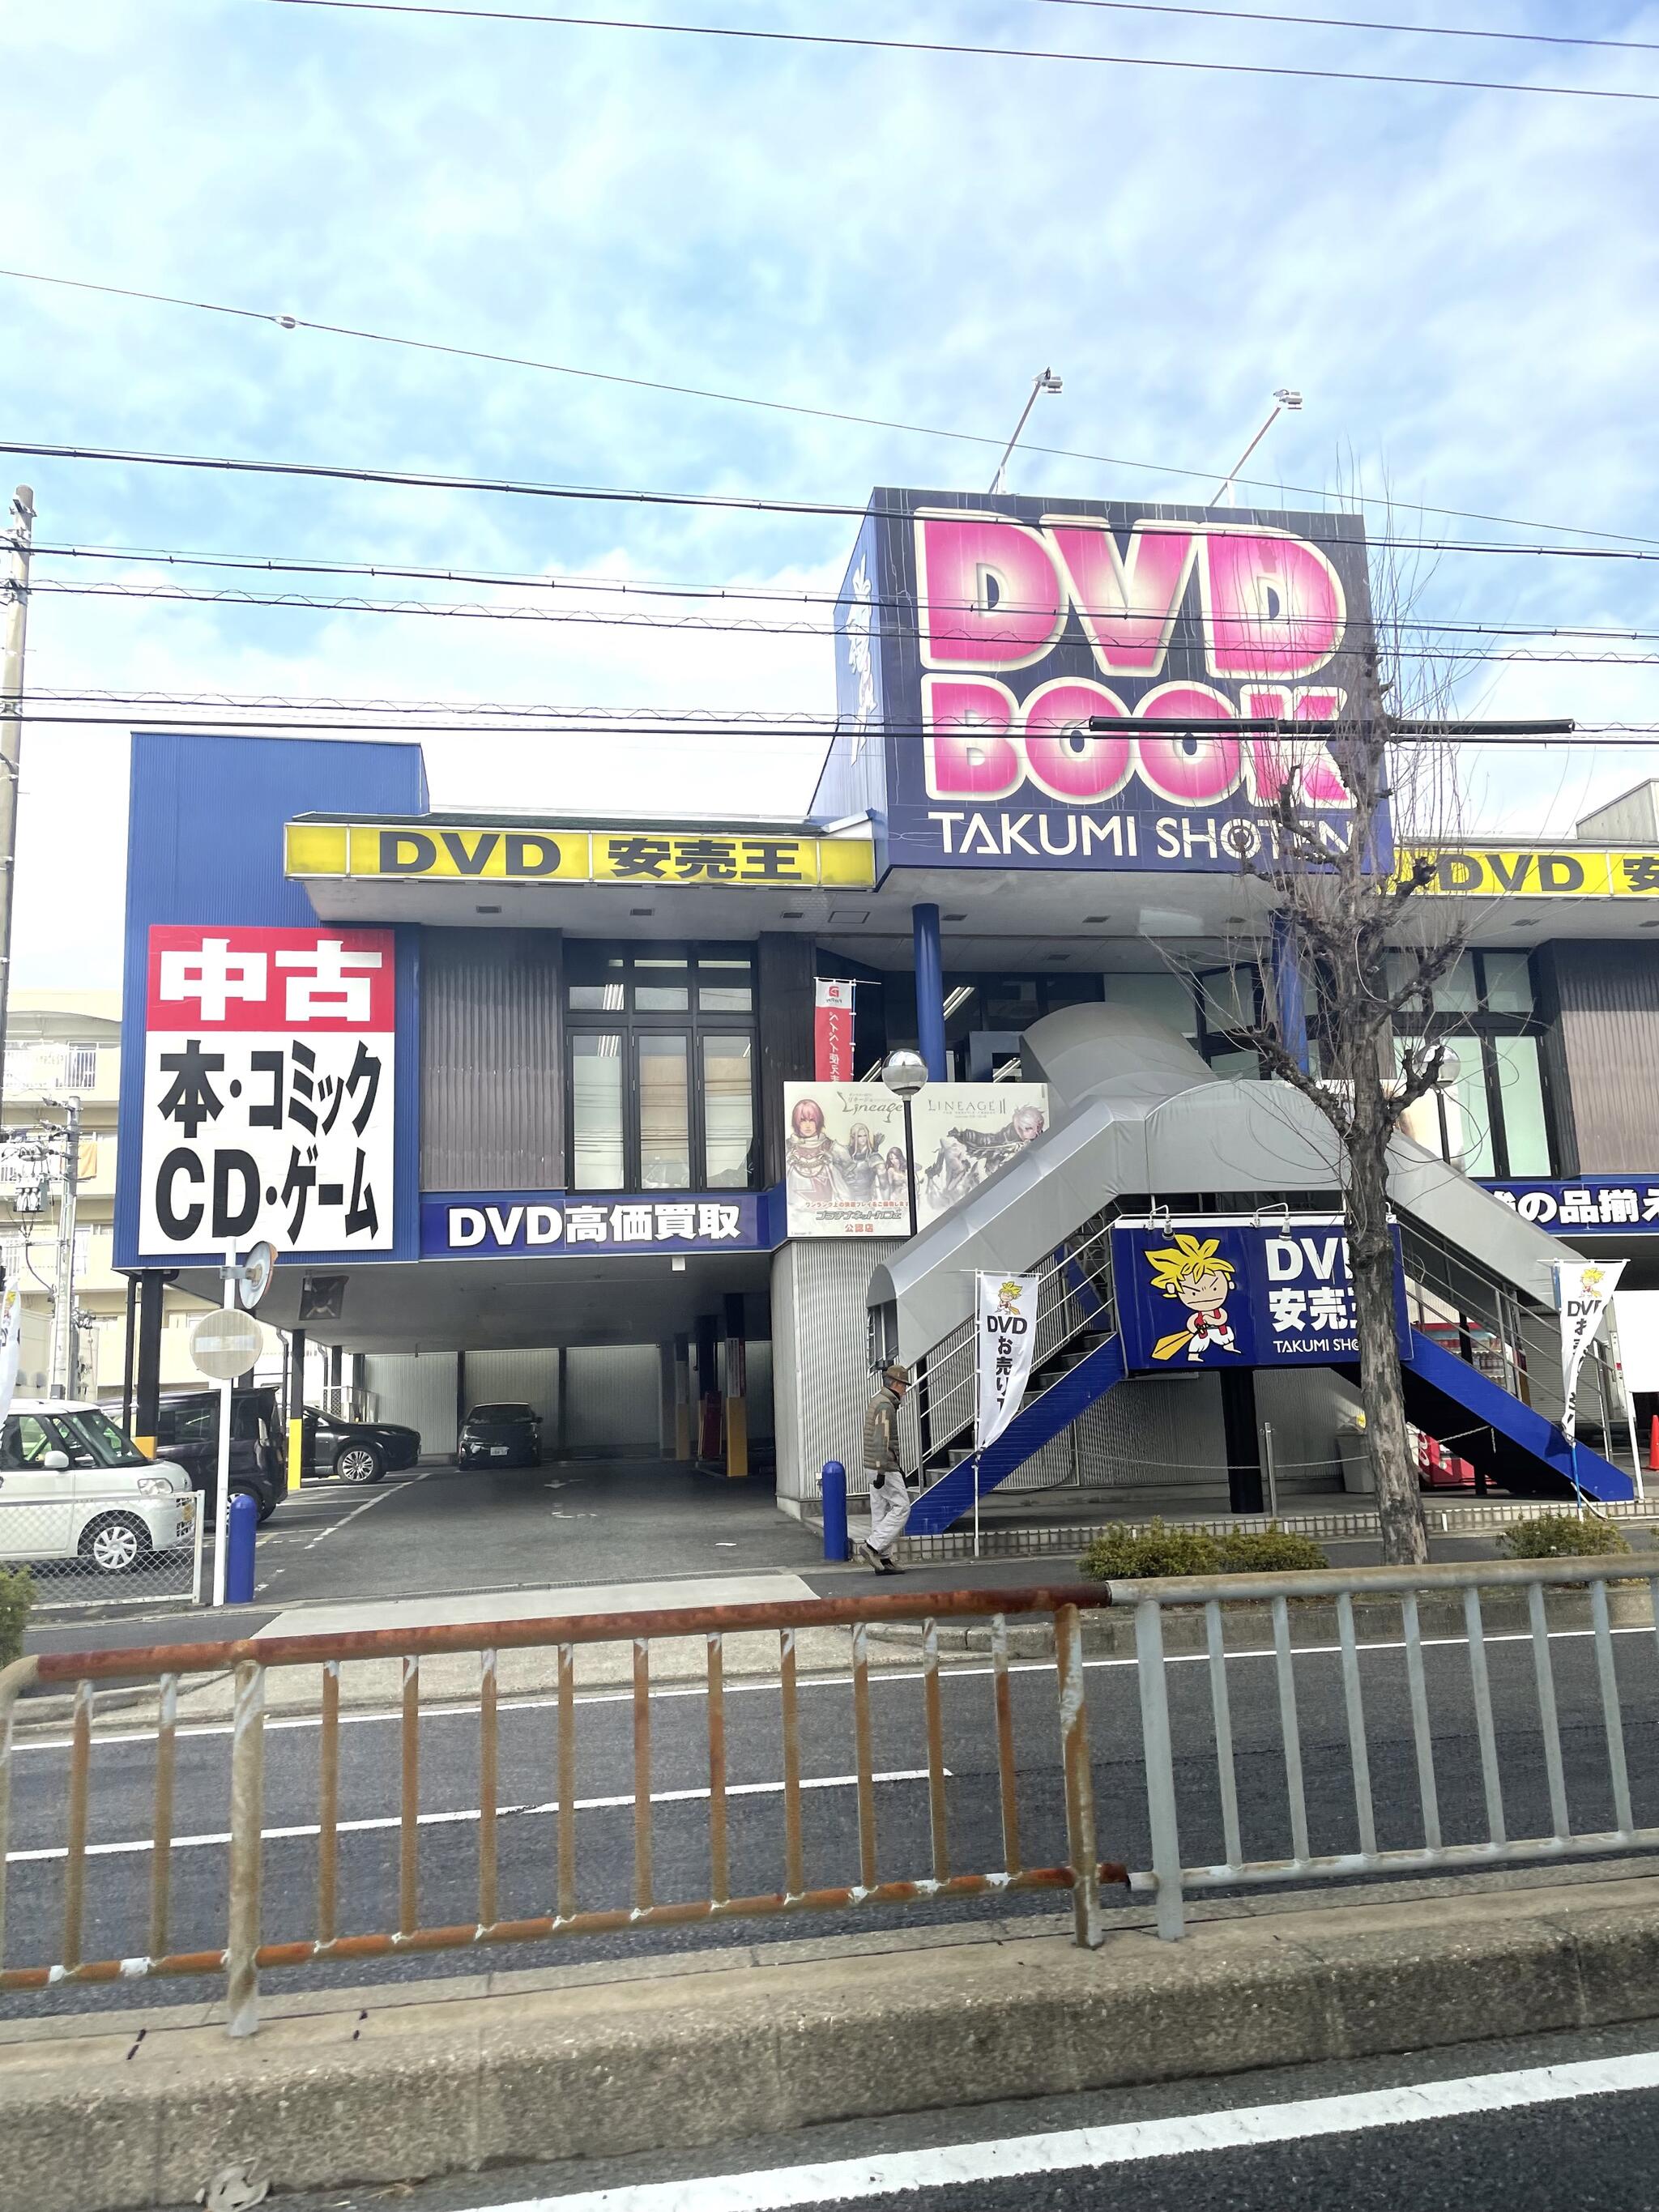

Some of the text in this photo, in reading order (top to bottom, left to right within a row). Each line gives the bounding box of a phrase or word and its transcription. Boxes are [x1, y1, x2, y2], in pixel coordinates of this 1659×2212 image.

[914, 506, 1346, 680] DVD
[920, 673, 1358, 809] BOOK
[379, 830, 803, 880] DVD 安売王
[928, 812, 1137, 857] TAKUMI
[1438, 854, 1584, 892] DVD
[160, 938, 382, 1022] 中古
[158, 1038, 382, 1139] 本・コミック
[837, 1091, 903, 1123] Lineage
[927, 1098, 995, 1110] LINEAGE
[156, 1144, 379, 1245] CD・ゲーム
[449, 1203, 741, 1247] DVD高価買取
[845, 1224, 874, 1233] 公認店
[1265, 1238, 1354, 1281] DV
[987, 1315, 1028, 1335] DVD
[1269, 1286, 1358, 1333] 安売
[1273, 1337, 1360, 1353] TAKUMI SHO
